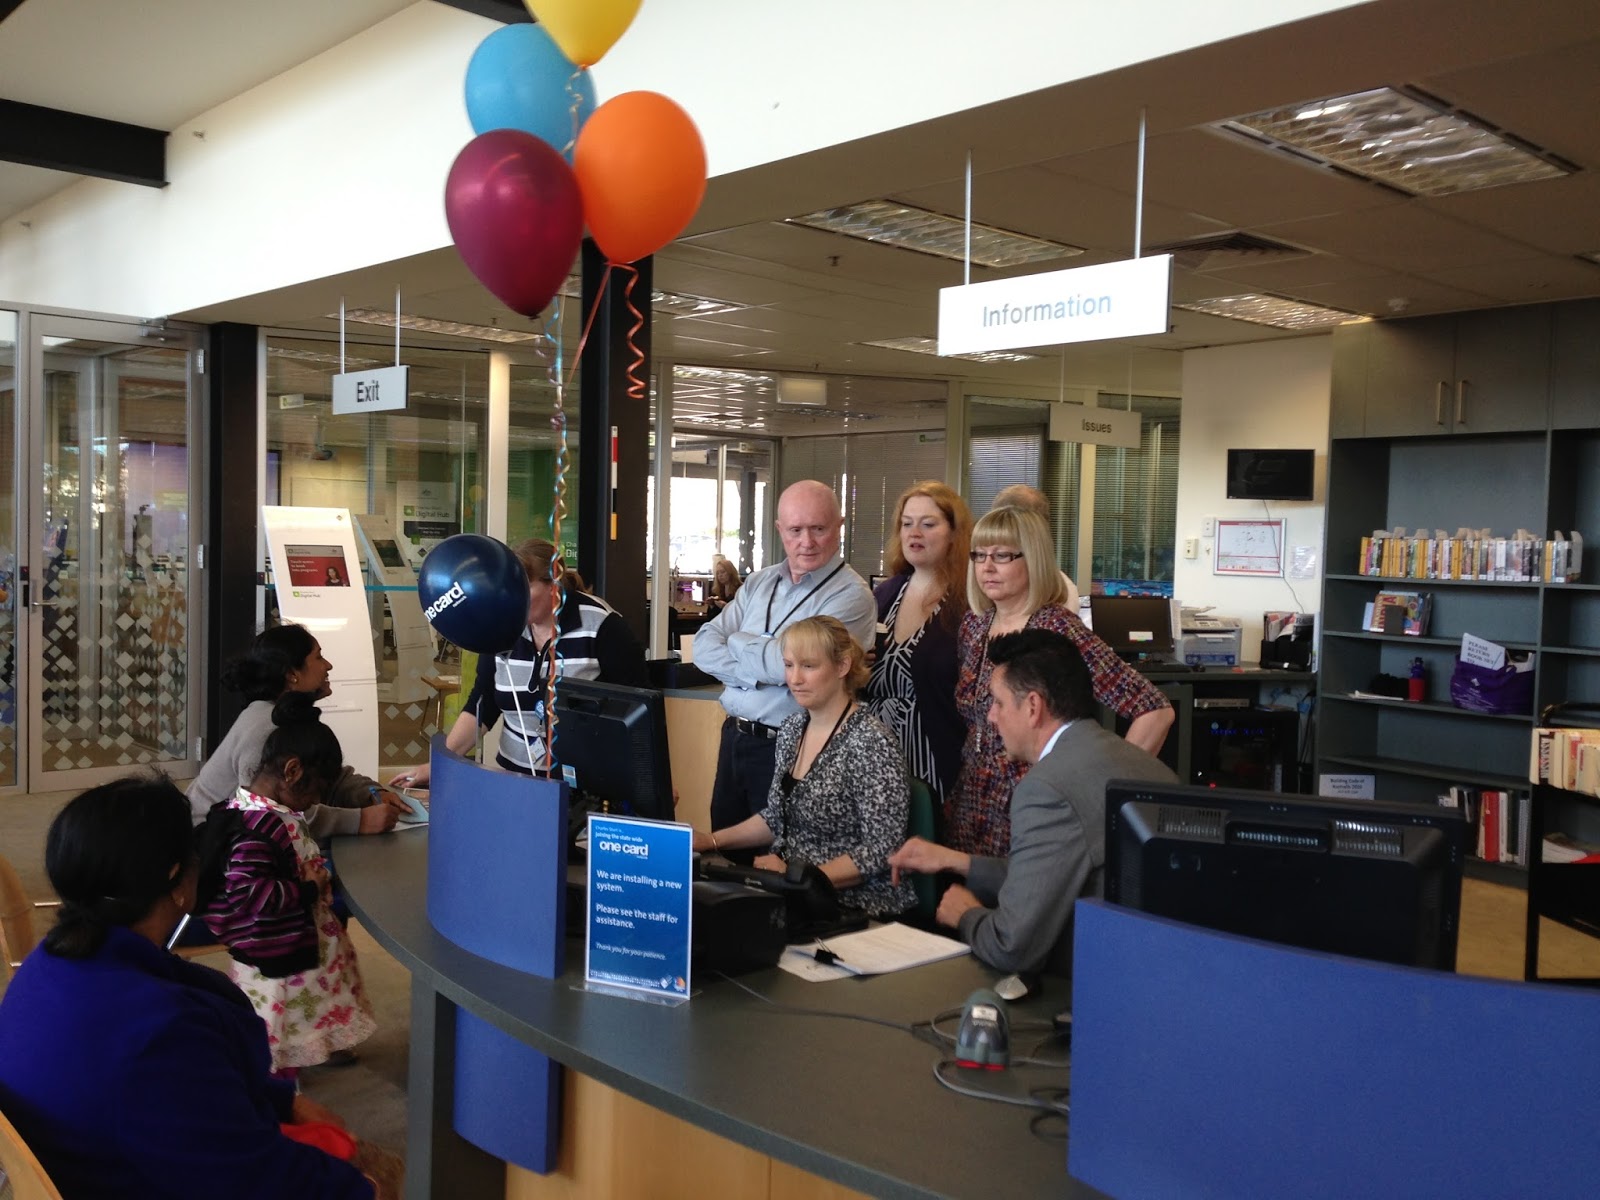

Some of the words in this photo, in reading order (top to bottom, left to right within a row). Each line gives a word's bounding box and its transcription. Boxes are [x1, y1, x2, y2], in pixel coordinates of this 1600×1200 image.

[982, 294, 1112, 327] Information
[357, 380, 379, 402] Exit
[1081, 418, 1112, 434] Issues
[424, 606, 437, 622] ne
[433, 581, 465, 613] card
[1468, 641, 1488, 651] PLEASE
[1468, 646, 1490, 657] RETURN
[599, 840, 621, 853] one
[622, 843, 649, 856] card
[596, 869, 609, 879] We
[610, 872, 622, 881] are
[623, 873, 658, 889] installing
[665, 881, 682, 890] new
[596, 882, 624, 893] system.
[595, 902, 619, 915] Please
[620, 909, 633, 917] see
[634, 909, 647, 919] the
[648, 912, 665, 922] staff
[666, 913, 679, 924] for
[595, 916, 635, 929] assistance.
[595, 942, 611, 951] Thank
[612, 945, 622, 953] you
[622, 946, 630, 955] for
[630, 948, 643, 957] your
[643, 951, 667, 960] patience.
